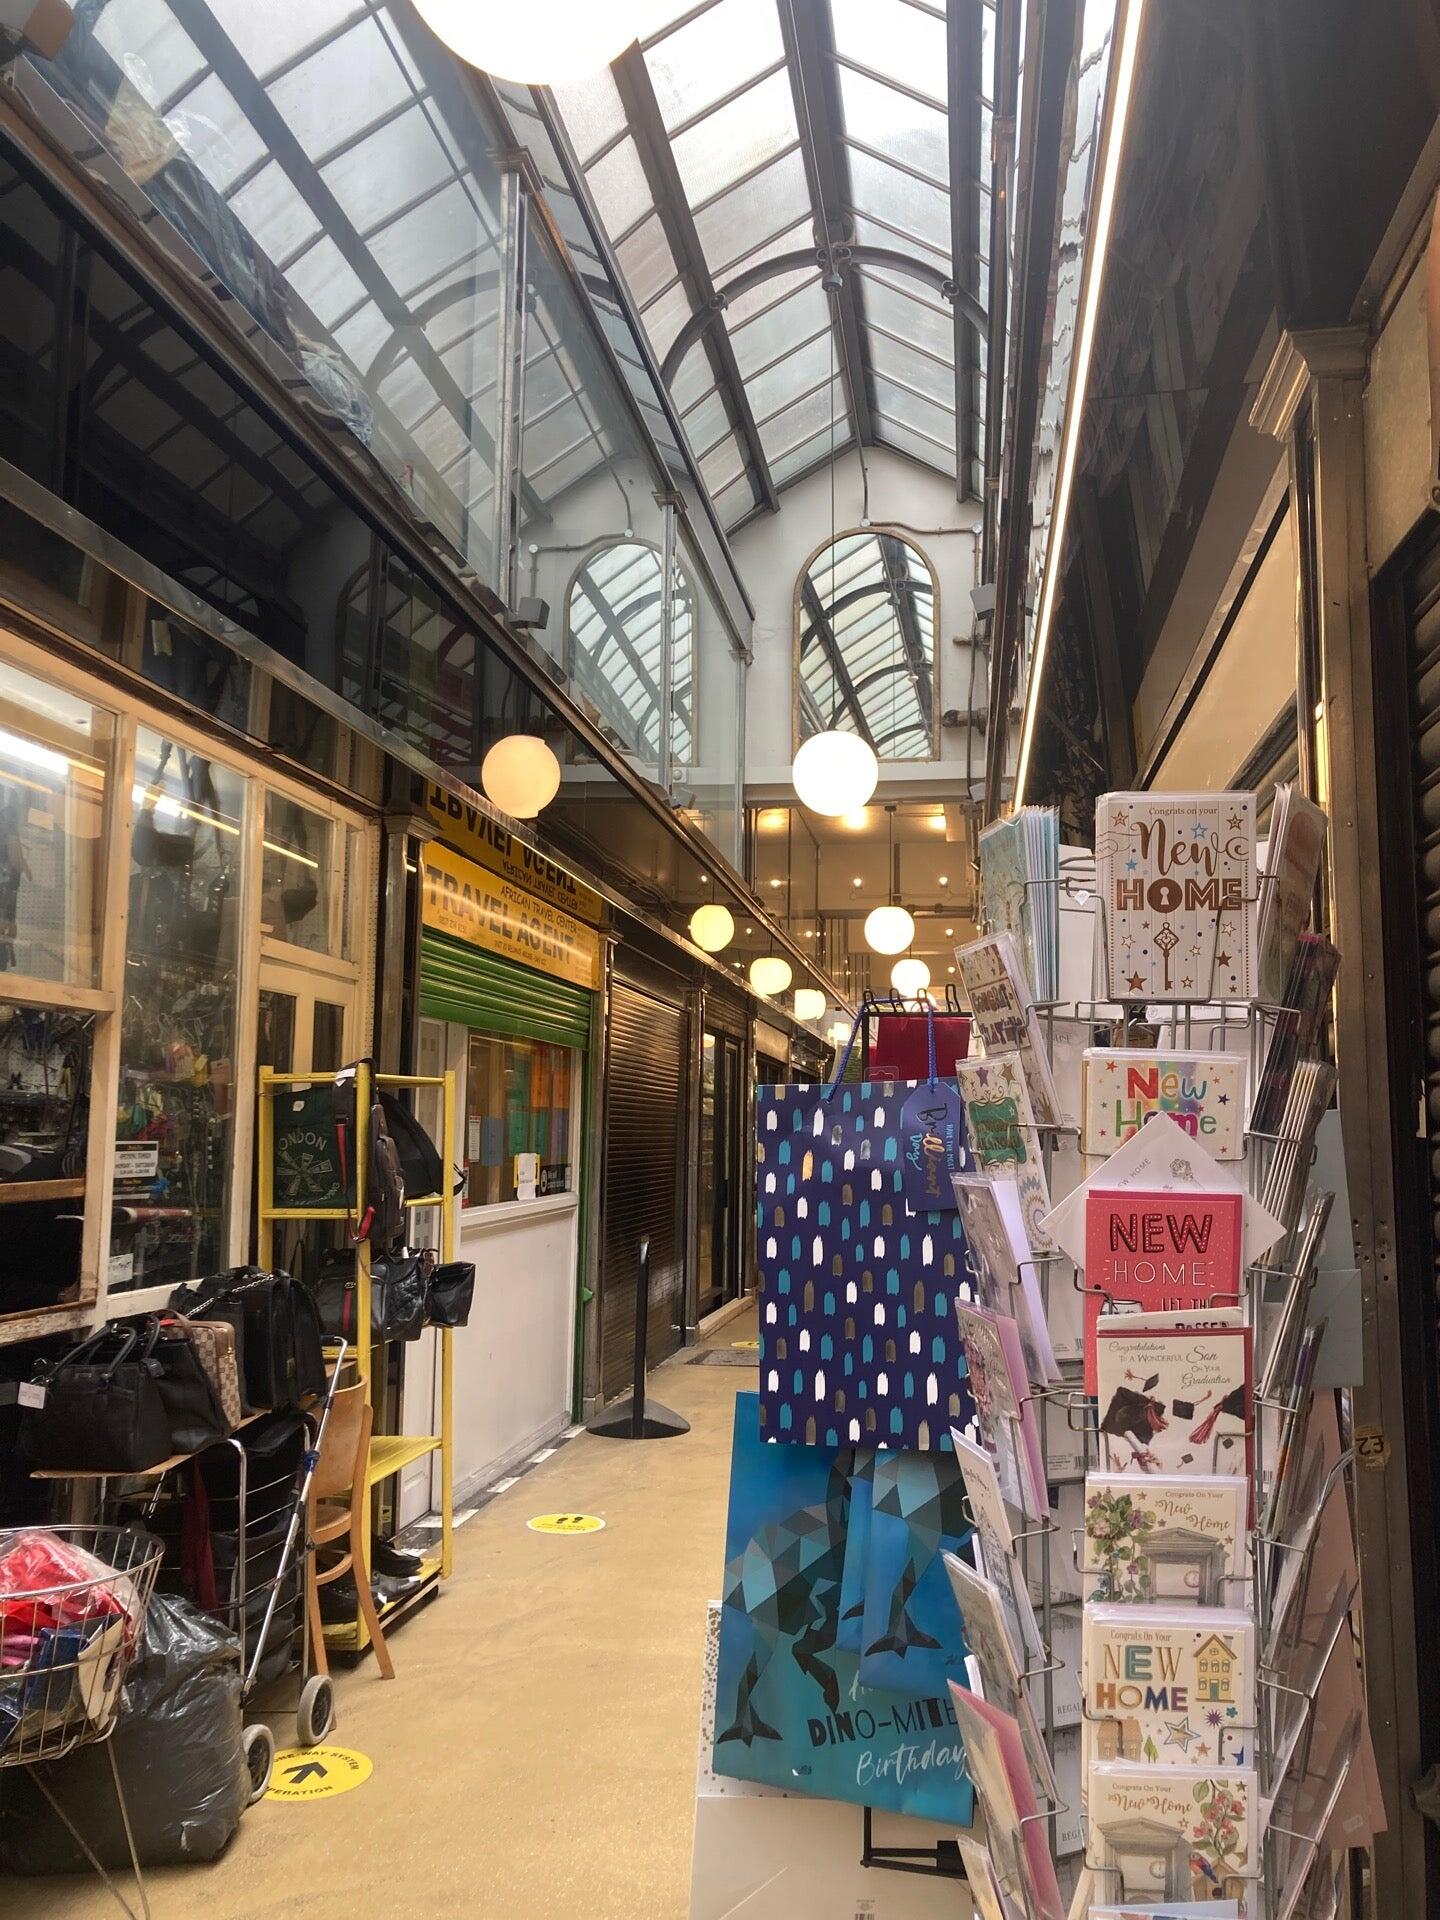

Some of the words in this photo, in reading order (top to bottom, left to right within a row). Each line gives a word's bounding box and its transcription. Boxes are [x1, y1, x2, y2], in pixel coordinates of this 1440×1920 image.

[1149, 807, 1185, 816] Congrats
[1199, 808, 1219, 817] your
[1125, 818, 1232, 877] New
[501, 886, 531, 910] AFRICAN
[532, 901, 554, 924] TRAVEL
[1116, 878, 1242, 913] HOME
[427, 864, 513, 941] TRAVEL
[517, 911, 575, 965] AGENT
[1127, 1067, 1208, 1100] New
[278, 1131, 327, 1151] ONDON
[1110, 1213, 1213, 1254] NEW
[1114, 1260, 1207, 1286] HOME
[1108, 1341, 1166, 1353] Congratulations
[1186, 1346, 1217, 1364] Son
[1181, 1373, 1232, 1390] Graduation
[1165, 1490, 1195, 1499] Congrats
[1196, 1491, 1206, 1499] On
[1155, 1500, 1192, 1517] New
[1186, 1514, 1231, 1532] Home
[1110, 1630, 1143, 1641] Congrats
[1143, 1631, 1153, 1641] On
[1155, 1632, 1172, 1642] Your
[1103, 1644, 1183, 1682] NEW
[1096, 1682, 1189, 1713] HOME
[330, 1752, 360, 1770] SYSTEM
[856, 1739, 967, 1786] Birthday
[266, 1785, 334, 1796] PERATION
[1112, 1783, 1142, 1792] Congrats
[1143, 1784, 1154, 1792] On
[1155, 1785, 1171, 1793] Your
[1108, 1793, 1146, 1811] New
[1147, 1796, 1193, 1815] Home
